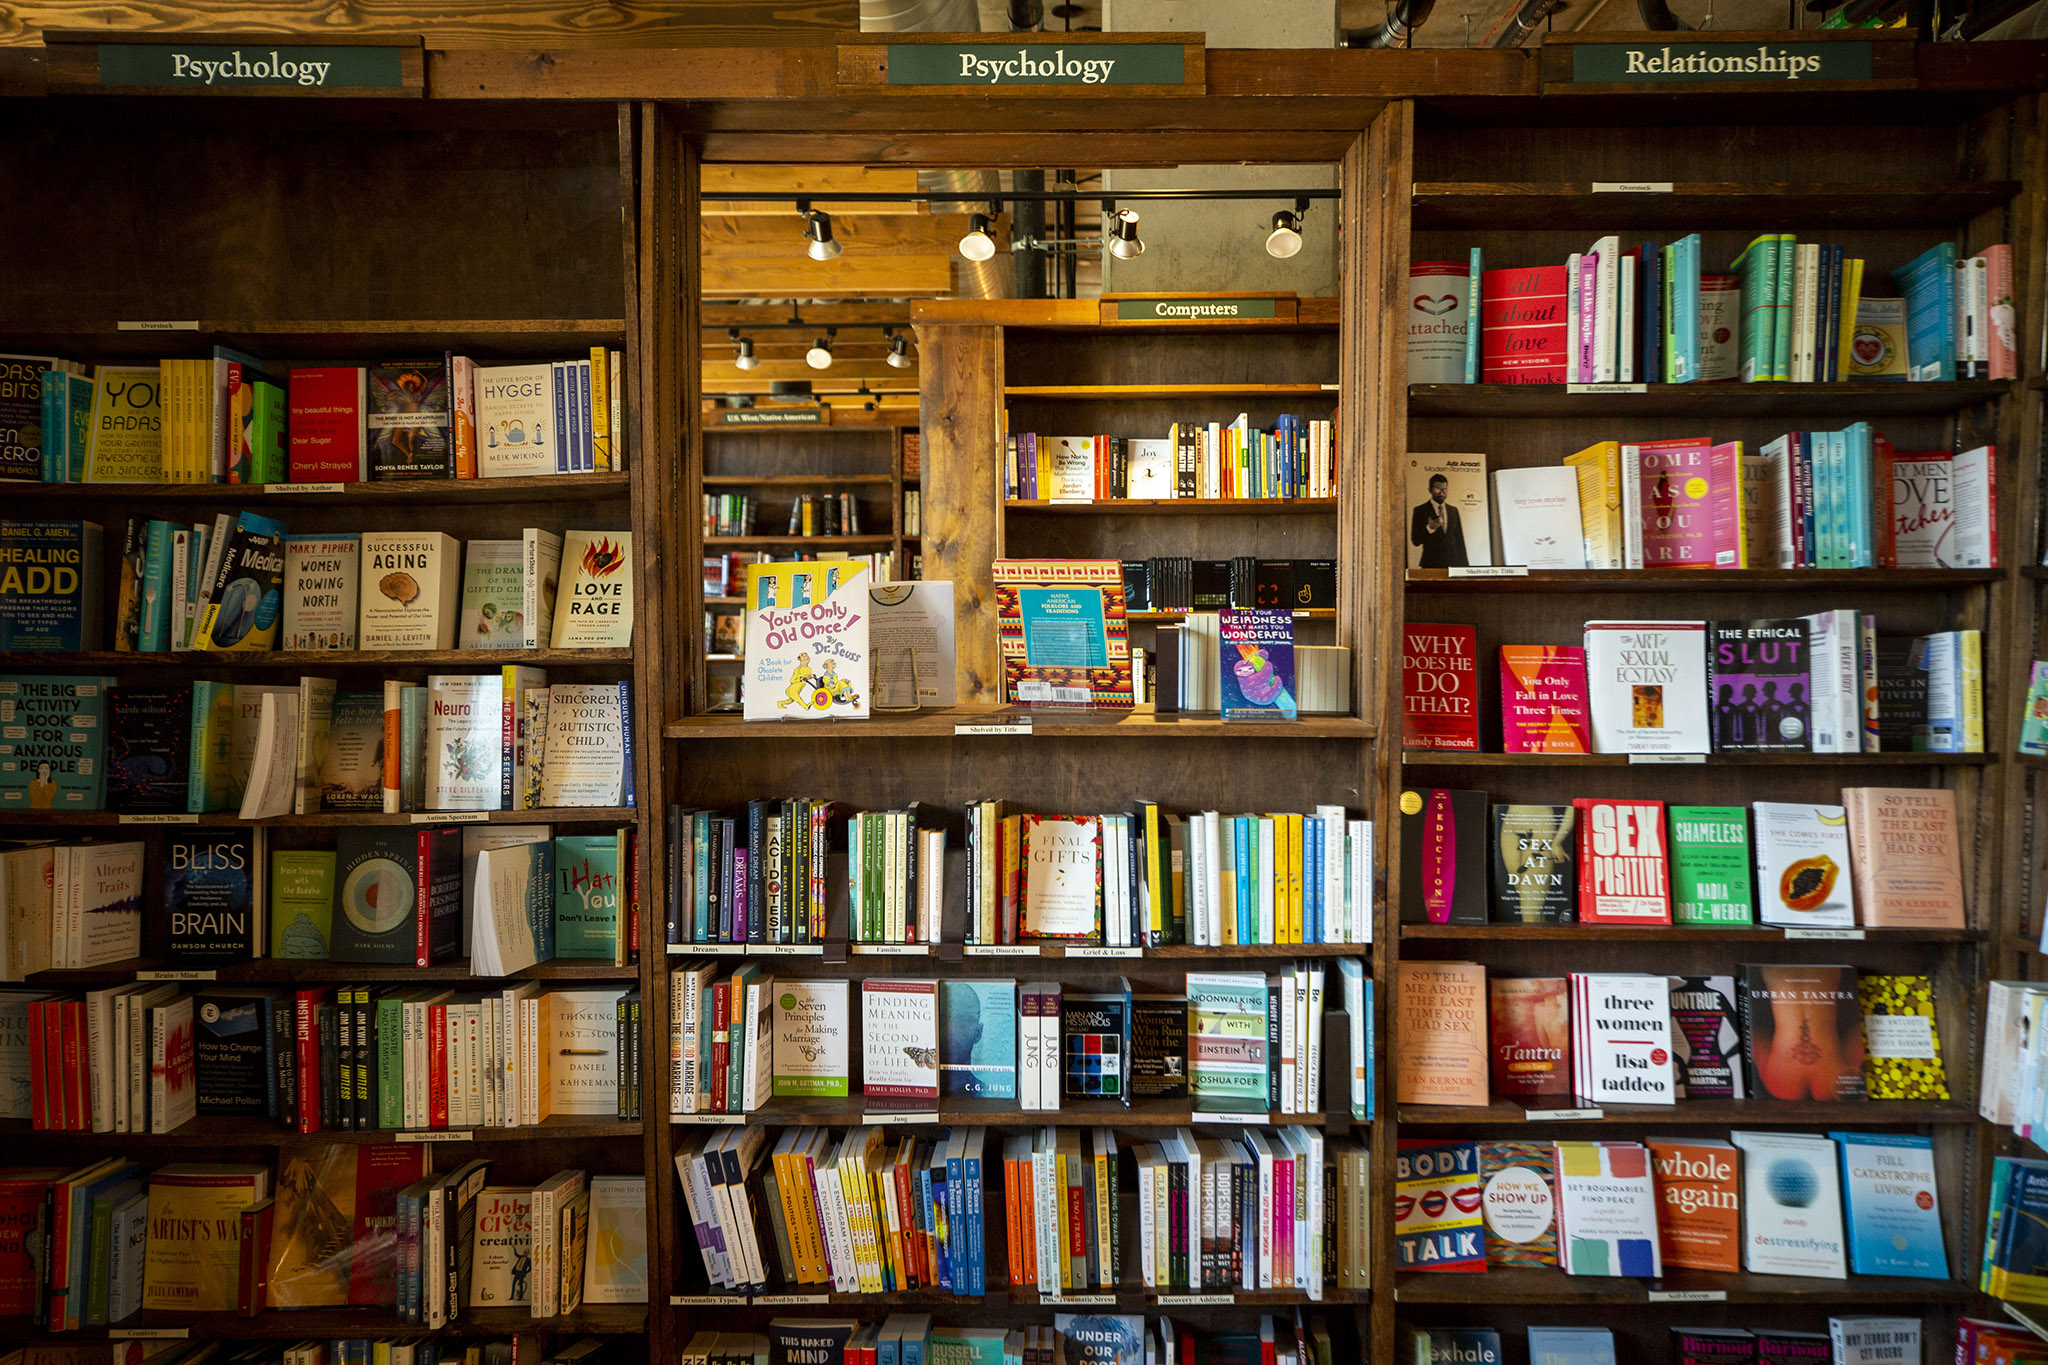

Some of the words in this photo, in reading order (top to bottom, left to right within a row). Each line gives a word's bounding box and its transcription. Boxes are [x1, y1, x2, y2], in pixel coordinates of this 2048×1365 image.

[172, 51, 331, 86] Psychology
[959, 49, 1116, 84] Psychology
[1625, 46, 1822, 80] Relationships
[1620, 184, 1652, 192] Overstock
[1512, 273, 1541, 293] all
[1155, 303, 1238, 319] Computers
[1497, 303, 1557, 324] about
[1505, 331, 1548, 351] love
[485, 383, 543, 400] HYGGE
[1586, 385, 1632, 393] Relationships
[292, 406, 304, 416] tiny
[304, 405, 332, 414] beautiful
[333, 405, 354, 415] things
[292, 437, 309, 445] Dear
[310, 436, 332, 447] Sugar
[292, 462, 318, 473] Cheryl
[320, 461, 353, 472] Strayed
[374, 464, 395, 472] SONYA
[417, 463, 445, 471] TAYLOR
[1066, 460, 1086, 468] Wrong
[275, 484, 299, 492] Shelved
[301, 484, 308, 493] by
[312, 484, 333, 492] Author
[289, 543, 316, 554] MARY
[322, 542, 355, 553] PIPHER
[367, 543, 435, 552] SUCCESSFUL
[0, 547, 80, 564] HEALING
[372, 554, 428, 569] AGING
[301, 560, 341, 573] WOMEN
[0, 566, 79, 594] ADD
[298, 576, 344, 590] ROWING
[574, 583, 623, 596] LOVE
[303, 594, 338, 608] NORTH
[571, 602, 620, 615] RAGE
[760, 611, 808, 631] You're
[811, 601, 847, 621] Only
[1221, 615, 1293, 625] WEIRDNESS
[766, 628, 798, 650] Old
[801, 614, 861, 640] Once!
[1221, 629, 1294, 640] WONDERFUL
[1717, 629, 1743, 640] THE
[1747, 628, 1802, 640] ETHICAL
[1407, 634, 1467, 656] WHY
[812, 642, 830, 656] Dr.
[833, 642, 861, 663] Seuss
[1717, 642, 1801, 666] SLUT
[1403, 656, 1446, 671] DOES
[1449, 659, 1473, 672] HE
[757, 674, 783, 682] Children
[1416, 672, 1460, 694] DO
[1520, 676, 1541, 689] You
[1543, 676, 1571, 690] Only
[21, 684, 49, 697] THE
[50, 684, 76, 697] BIG
[1515, 690, 1535, 701] Fall
[1538, 690, 1549, 701] in
[1552, 690, 1580, 702] Love
[15, 699, 81, 713] ACTIVITY
[502, 695, 511, 712] THE
[1405, 695, 1471, 715] THAT?
[572, 708, 605, 718] YOUR
[1513, 705, 1547, 716] Three
[1550, 705, 1582, 717] Times
[26, 715, 73, 728] BOOK
[33, 730, 64, 743] FOR
[502, 714, 512, 754] PATTERN
[567, 736, 605, 746] CHILD
[13, 745, 83, 758] ANXIOUS
[502, 756, 511, 797] SEEKERS
[425, 814, 447, 822] Autism
[448, 813, 478, 822] Spectrum
[1591, 804, 1662, 857] SEX
[1675, 823, 1744, 844] SHAMELESS
[1043, 835, 1084, 847] FINAL
[1518, 838, 1553, 851] SEX
[172, 843, 246, 870] BLISS
[1034, 850, 1090, 864] GIFTS
[1523, 856, 1546, 869] AT
[1507, 873, 1563, 887] DAWN
[1594, 857, 1665, 896] POSITIVE
[172, 912, 245, 935] BRAIN
[559, 914, 583, 923] Don't
[584, 914, 610, 923] Leave
[775, 946, 796, 954] Drugs
[975, 947, 995, 955] Eating
[1083, 949, 1101, 957] Grief
[1110, 949, 1126, 957] Loss
[154, 972, 173, 980] Brain
[181, 972, 199, 980] Mind
[868, 995, 929, 1009] FINDING
[1191, 994, 1262, 1006] MOONWALKING
[1751, 990, 1797, 1001] URBAN
[1802, 990, 1855, 1001] TANTRA
[798, 1001, 826, 1010] Seven
[1604, 995, 1654, 1011] three
[784, 1013, 825, 1024] Principles
[868, 1011, 932, 1021] MEANING
[805, 1025, 838, 1036] Making
[1226, 1021, 1251, 1029] WITH
[1595, 1018, 1664, 1031] women
[783, 1035, 821, 1046] Marriage
[868, 1033, 920, 1043] SECOND
[868, 1046, 900, 1055] HALF
[1024, 1035, 1039, 1068] JUNG
[1198, 1046, 1241, 1055] EINSTEIN
[1500, 1041, 1562, 1062] Tantra
[570, 1063, 607, 1072] DANIEL
[884, 1057, 909, 1068] LIFE
[1615, 1053, 1648, 1070] lisa
[559, 1079, 616, 1088] KAHNEMAN
[1196, 1076, 1232, 1086] JOSHUA
[1234, 1076, 1260, 1086] FOER
[1601, 1075, 1665, 1093] taddeo
[965, 1083, 984, 1092] C.G.
[988, 1084, 1012, 1093] JUNG
[698, 1116, 726, 1124] Marriage
[893, 1116, 908, 1124] Jung
[1396, 1146, 1472, 1179] BODY
[1654, 1152, 1732, 1180] whole
[1876, 1155, 1904, 1167] FULL
[1854, 1168, 1932, 1183] CATASTROPHE
[1875, 1184, 1912, 1197] LIVING
[1489, 1193, 1529, 1205] SHOW
[1530, 1193, 1548, 1206] UP
[1666, 1186, 1738, 1214] again
[150, 1218, 212, 1243] ARTIST'S
[1398, 1231, 1479, 1263] TALK
[1754, 1234, 1840, 1255] destressifying
[679, 1296, 717, 1305] Personality
[719, 1296, 739, 1305] Types
[779, 1337, 800, 1348] THIS
[800, 1337, 835, 1349] NAKED
[1075, 1330, 1122, 1344] UNDER
[1084, 1346, 1113, 1358] OUR
[1758, 1339, 1830, 1358] Burnout
